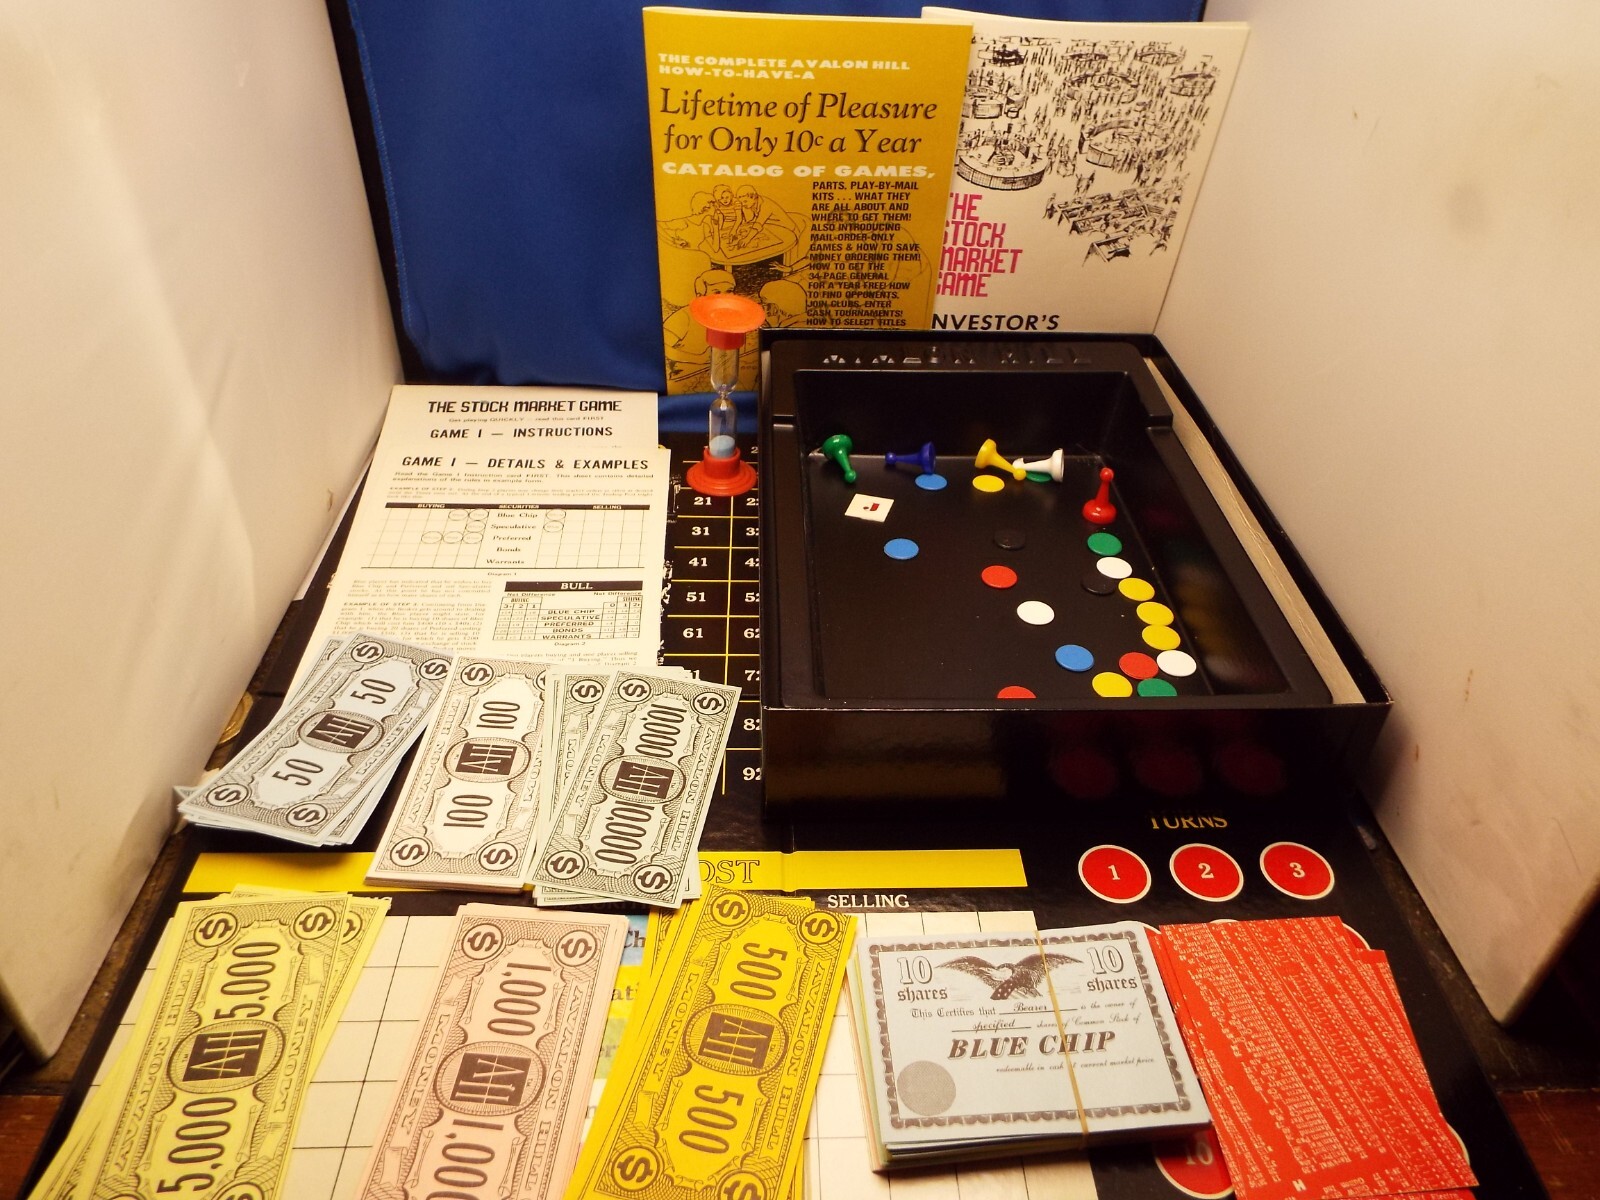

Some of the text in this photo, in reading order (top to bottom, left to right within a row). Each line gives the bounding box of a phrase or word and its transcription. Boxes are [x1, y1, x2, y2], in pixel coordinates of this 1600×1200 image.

[658, 53, 911, 71] THE COMPLETE AVALON HILL
[659, 65, 815, 80] HOW-TO-HAVE-A
[659, 87, 938, 123] Lifetime of Pleasure
[663, 123, 703, 154] for
[709, 126, 778, 157] Only
[828, 137, 847, 153] a
[854, 128, 923, 153] Year
[661, 161, 936, 179] CATALOG OF GAMES,
[850, 181, 919, 190] PLAY-BY-MAIL
[812, 192, 911, 201] KITS WHAT THEY
[812, 203, 909, 211] ARE ALL ABOUT AND
[811, 213, 912, 222] WHERE TO GET THEM!
[811, 223, 901, 232] ALSO INTRODUCING
[810, 233, 895, 242] MAIL-ORDER-ONLY
[809, 243, 920, 252] GAMES & HOW TO SAVE
[809, 253, 921, 262] MONEY ORDERING THEM!
[809, 262, 885, 271] HOW TO GET THE
[808, 272, 889, 281] 34-PAGE GENERAL
[807, 291, 819, 299] TO
[822, 291, 842, 299] FIND
[808, 282, 825, 290] FOR
[828, 282, 835, 290] A
[838, 282, 860, 290] YEAR
[889, 282, 911, 290] HOW
[806, 300, 828, 308] JOIN
[864, 300, 892, 308] ENTER
[806, 309, 904, 317] CASH TOURNAMENTS!
[806, 318, 907, 326] HOW TO SELECT TITLES
[931, 313, 1060, 331] NVESTOR'S
[428, 400, 622, 413] THE STOCK MARKET GAME
[430, 429, 470, 439] GAME
[513, 427, 614, 438] INSTRUCTIONS
[402, 456, 443, 467] GAME
[488, 458, 545, 469] DETAILS
[555, 460, 564, 469] &
[573, 459, 649, 470] EXAMPLES
[693, 496, 712, 506] 21
[691, 526, 710, 536] 31
[688, 557, 708, 567] 41
[560, 582, 594, 590] BULL
[686, 591, 706, 602] 51
[683, 628, 703, 639] 61
[350, 678, 396, 705] 50
[241, 671, 343, 773] AVALON HILL
[477, 701, 521, 730] 100
[635, 703, 688, 758] 10,000
[356, 712, 413, 776] MONEY
[410, 698, 461, 823] AVALON HILL
[272, 758, 324, 786] 50
[443, 794, 493, 828] 100
[595, 800, 655, 864] 10,000
[699, 859, 760, 884] OST
[1108, 862, 1306, 880] 1 2 3
[827, 894, 910, 909] SELLING
[729, 942, 789, 1001] 500
[896, 945, 1125, 985] 10 10
[213, 941, 281, 1021] 5,000
[897, 976, 1138, 1003] shares shares
[487, 962, 552, 1036] 1,000
[910, 1007, 935, 1020] This
[936, 1006, 975, 1018] Certifies
[978, 1005, 996, 1016] that
[1013, 1002, 1048, 1013] Bearer
[1104, 1001, 1126, 1009] owner
[653, 973, 700, 1082] MONEY
[972, 1019, 1016, 1034] specified
[1074, 1015, 1107, 1027] Common
[1109, 1012, 1129, 1024] Stock
[273, 994, 313, 1113] MONEY
[948, 1031, 1116, 1060] BLUE CHIP
[766, 961, 826, 1150] AVALON HILL
[114, 968, 193, 1172] AVALON HILL
[401, 1013, 450, 1134] MONEY
[996, 1057, 1155, 1073] redeemable cash current market price
[678, 1084, 745, 1154] 500
[156, 1097, 238, 1194] 5,000
